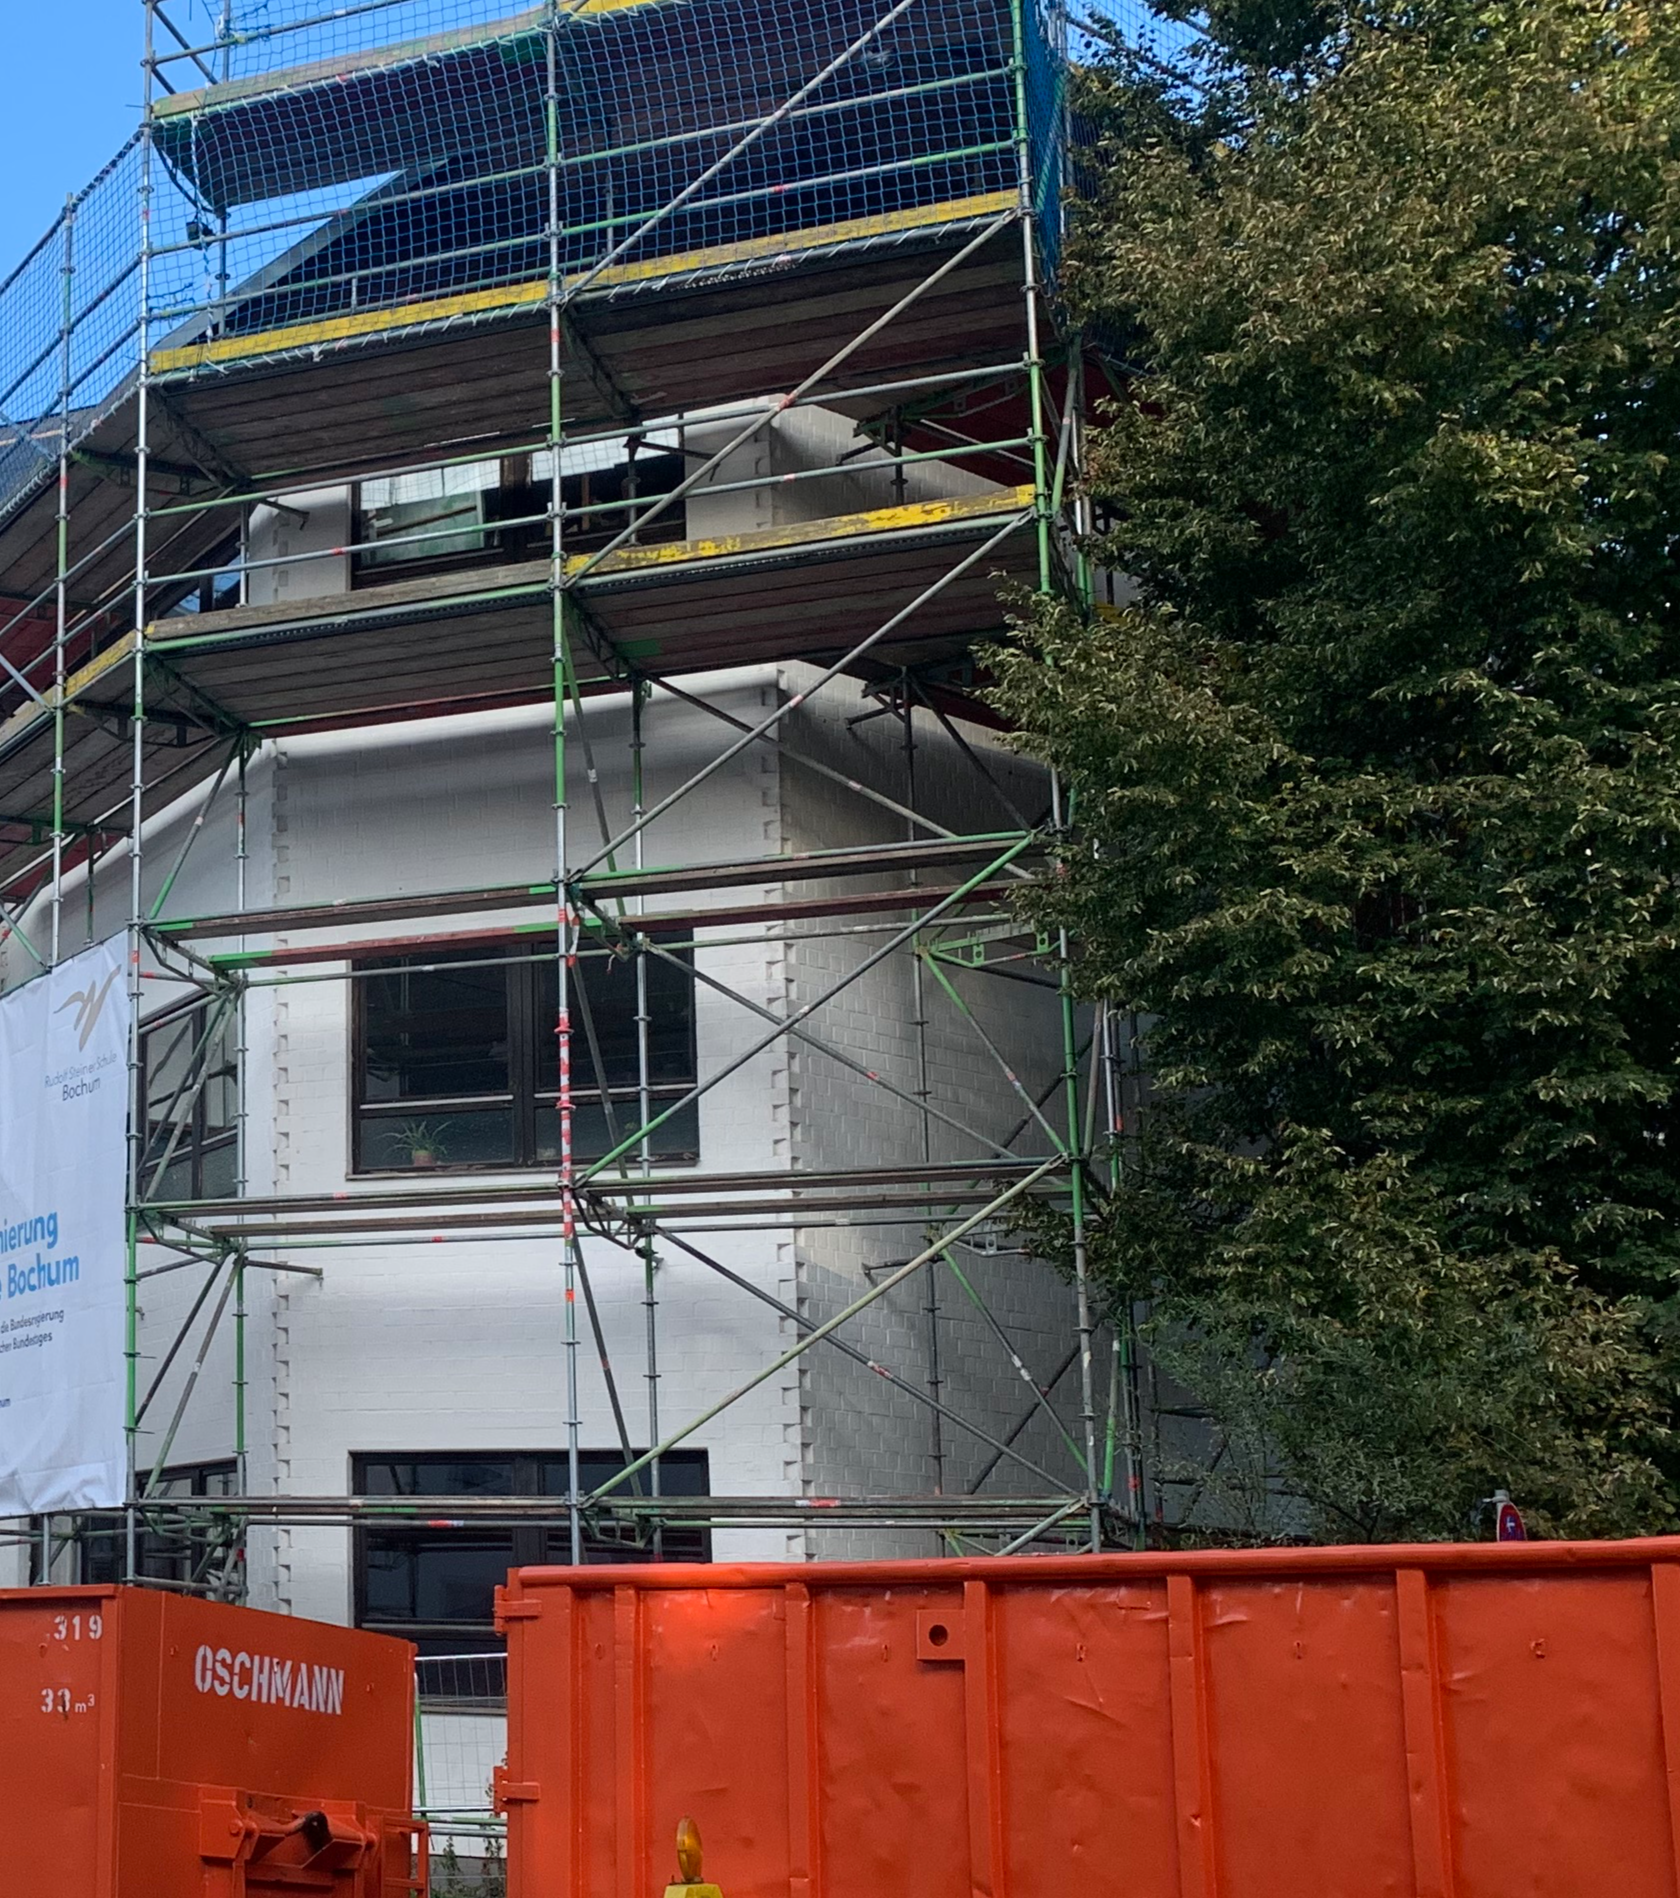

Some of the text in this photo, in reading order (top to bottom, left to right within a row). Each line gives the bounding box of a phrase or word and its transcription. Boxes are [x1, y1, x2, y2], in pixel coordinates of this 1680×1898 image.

[96, 1050, 117, 1070] Schule
[63, 1077, 100, 1101] Bochum
[8, 1253, 79, 1298] Bochum
[54, 1615, 102, 1640] 319
[195, 1644, 344, 1715] OSCHMANN
